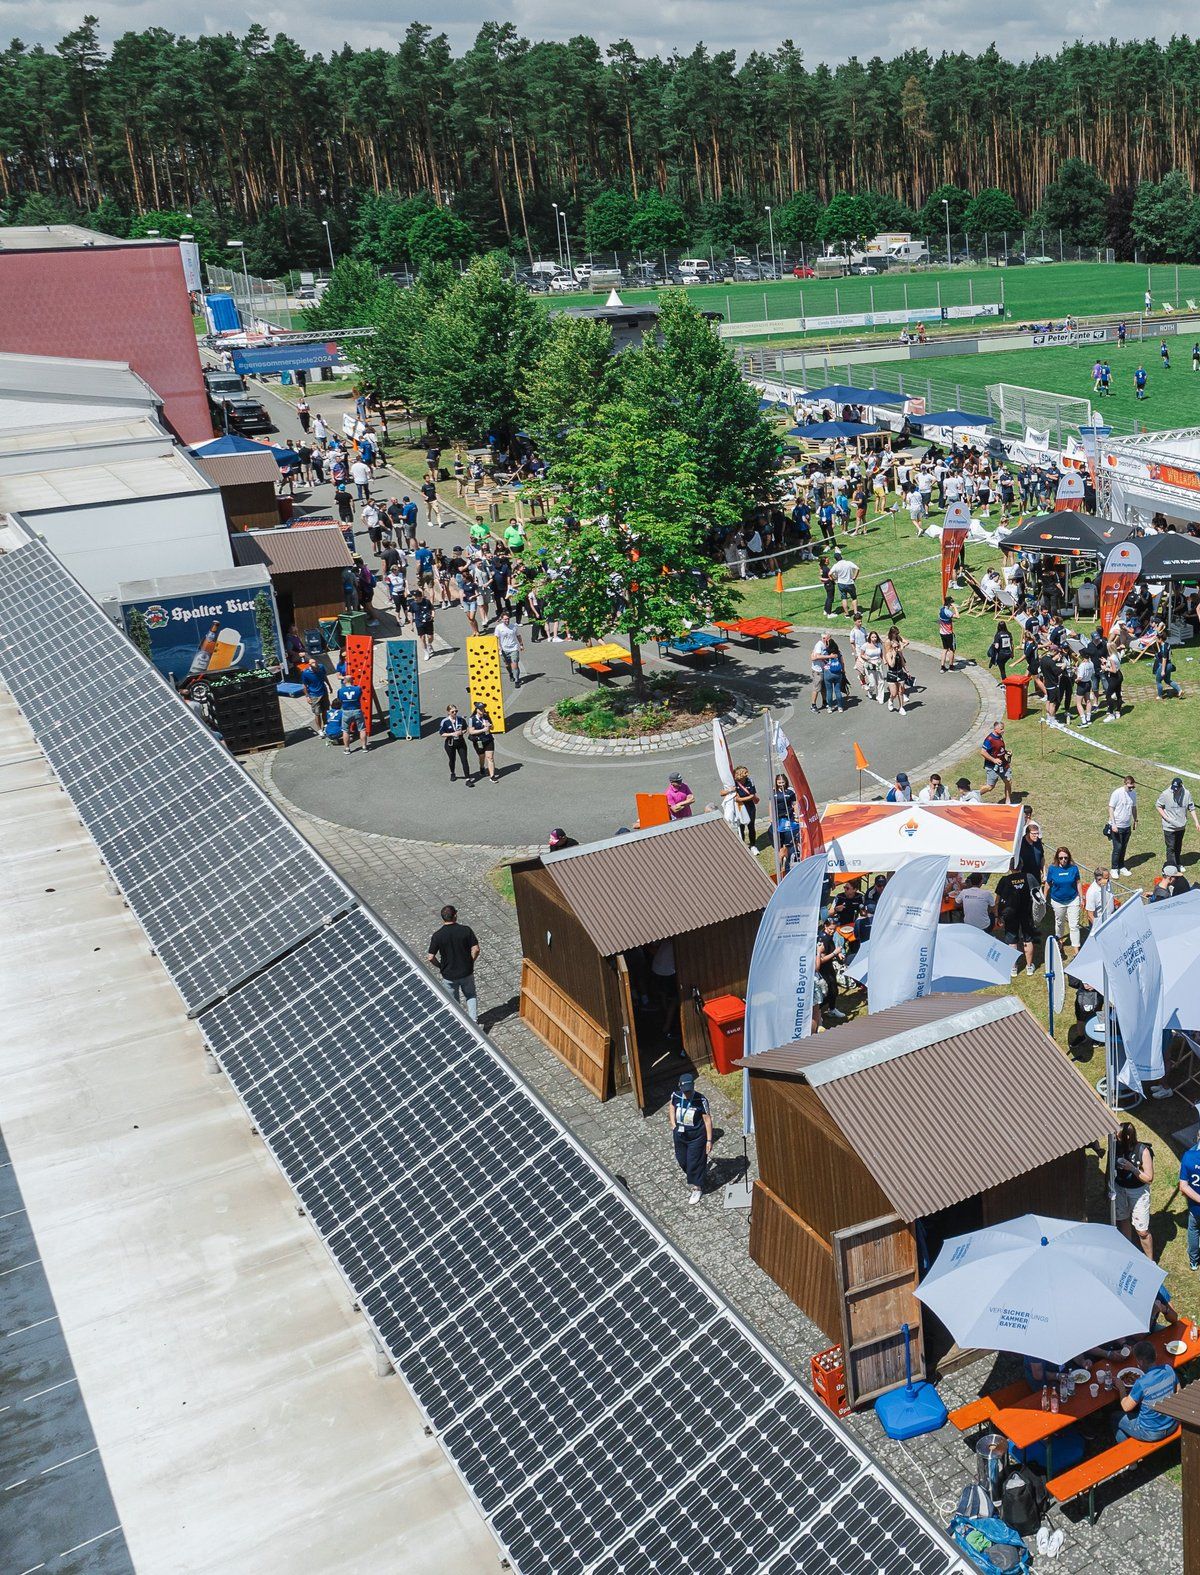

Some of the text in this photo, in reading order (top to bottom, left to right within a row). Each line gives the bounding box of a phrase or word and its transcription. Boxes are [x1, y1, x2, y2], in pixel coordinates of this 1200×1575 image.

[1047, 333, 1069, 342] Peter
[239, 355, 332, 369] #genosommerspiele2024
[171, 599, 256, 622] Spalter Bier
[960, 858, 986, 868] bwgv
[917, 946, 928, 979] Bayern
[797, 955, 806, 993] Bayern
[791, 993, 805, 1040] kammer
[999, 1320, 1027, 1330] BAYERN
[1001, 1314, 1029, 1324] KAMMER
